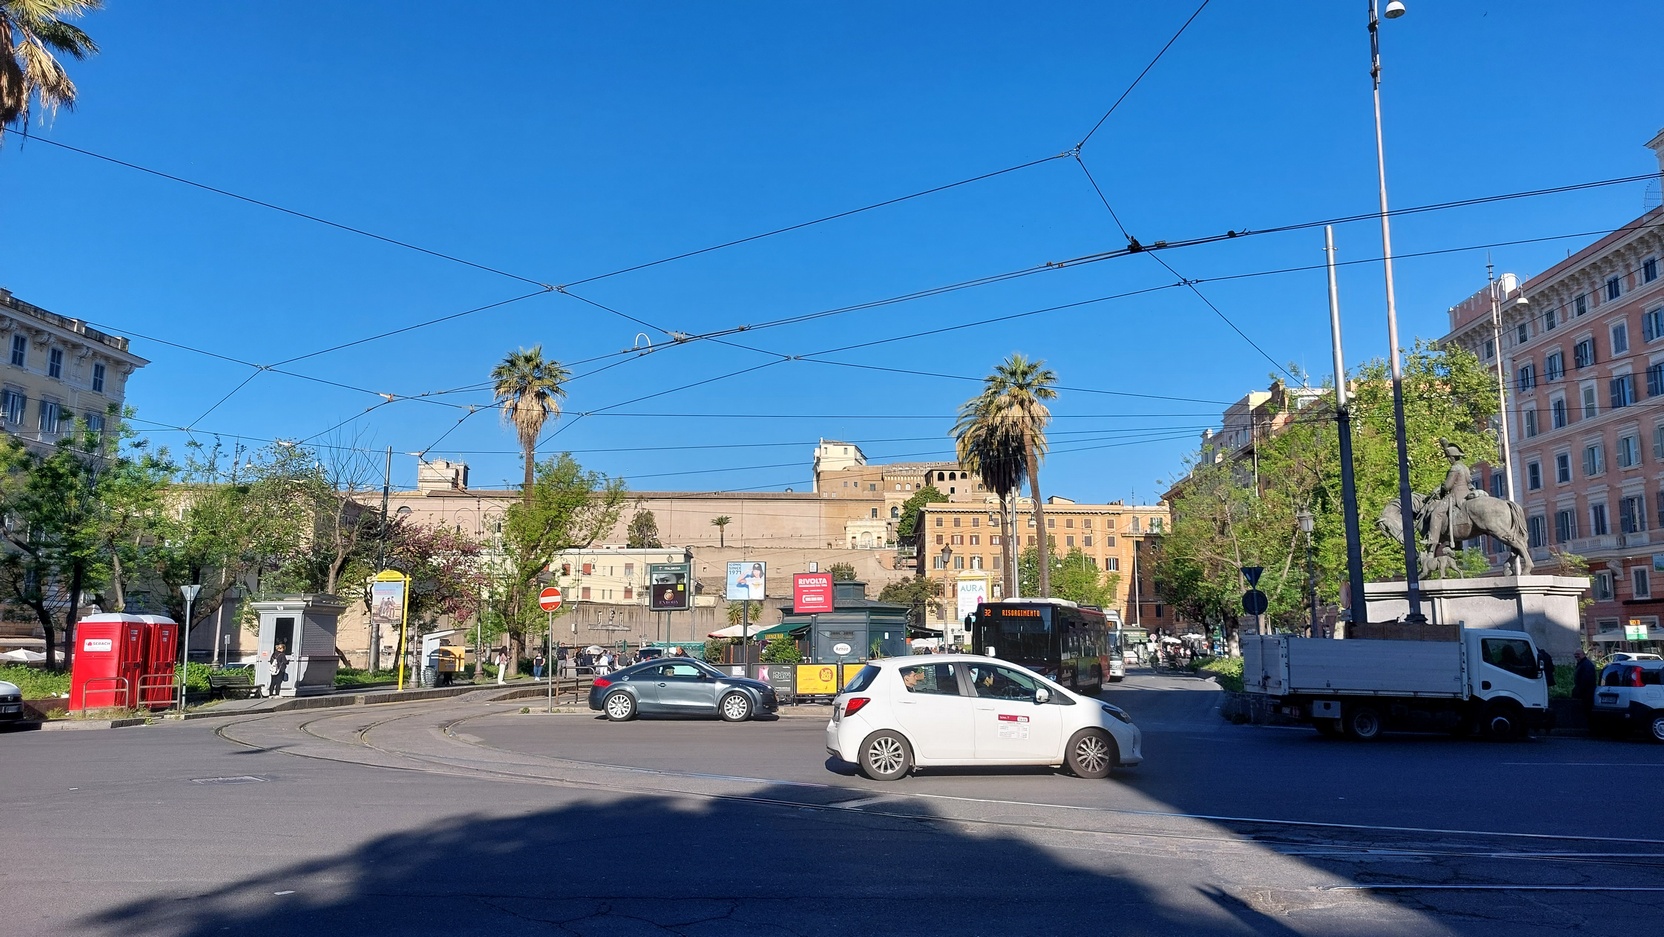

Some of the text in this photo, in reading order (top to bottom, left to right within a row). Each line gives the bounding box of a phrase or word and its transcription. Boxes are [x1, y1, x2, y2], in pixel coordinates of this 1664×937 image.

[960, 584, 985, 592] AURA
[984, 609, 1041, 617] 32 RISORGIMENTO
